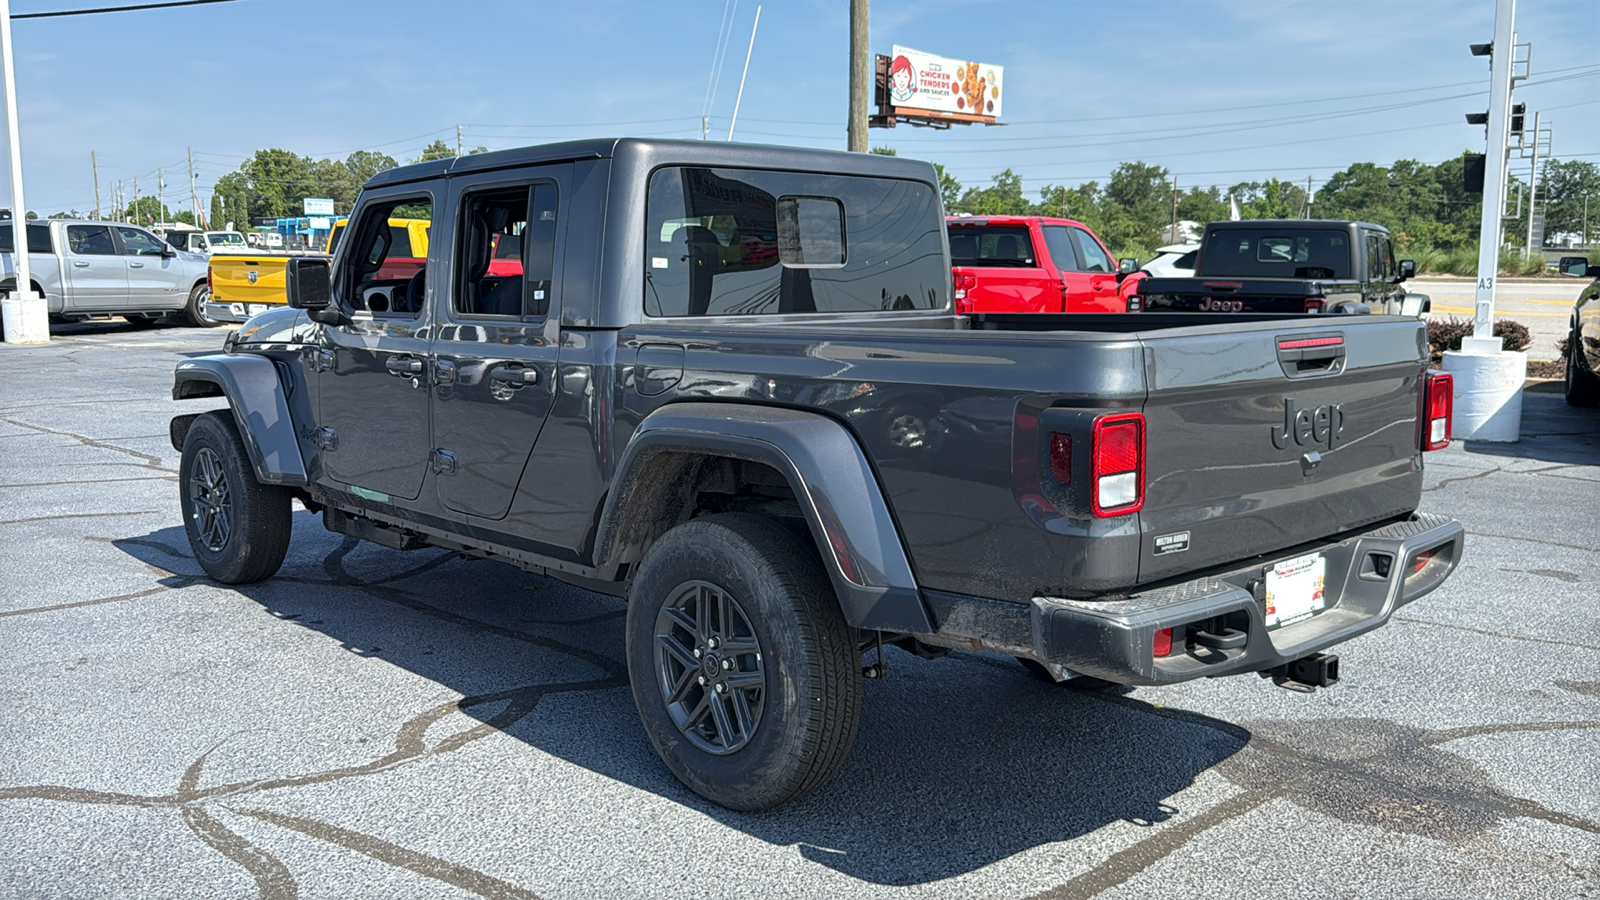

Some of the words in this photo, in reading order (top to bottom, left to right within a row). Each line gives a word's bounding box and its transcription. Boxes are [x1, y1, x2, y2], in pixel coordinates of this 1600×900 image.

[920, 70, 951, 80] CHICKEN
[920, 79, 950, 89] TENDERS
[1478, 277, 1493, 290] A3
[1198, 296, 1244, 313] Jeep
[1271, 398, 1344, 450] Jeep
